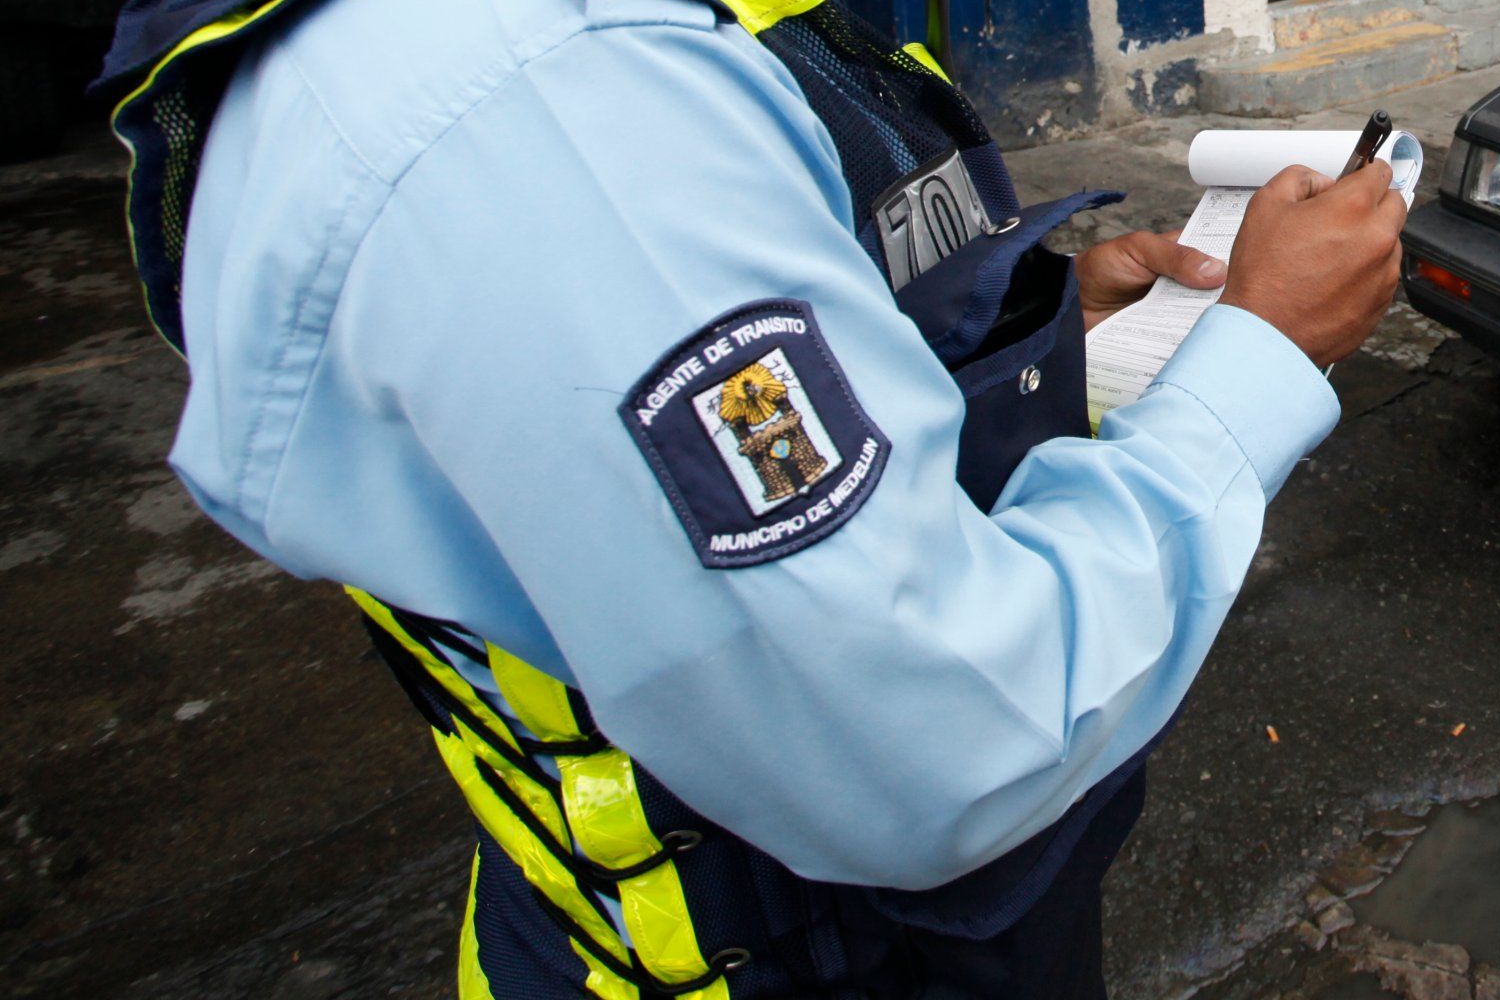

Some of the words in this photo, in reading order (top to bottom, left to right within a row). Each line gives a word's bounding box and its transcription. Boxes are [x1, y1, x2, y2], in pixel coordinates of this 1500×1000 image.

[636, 356, 706, 426] AGENTE
[703, 337, 734, 364] DE
[730, 316, 806, 347] TRANSITO
[710, 515, 806, 551] MUNICIPIO
[805, 498, 833, 523] DE
